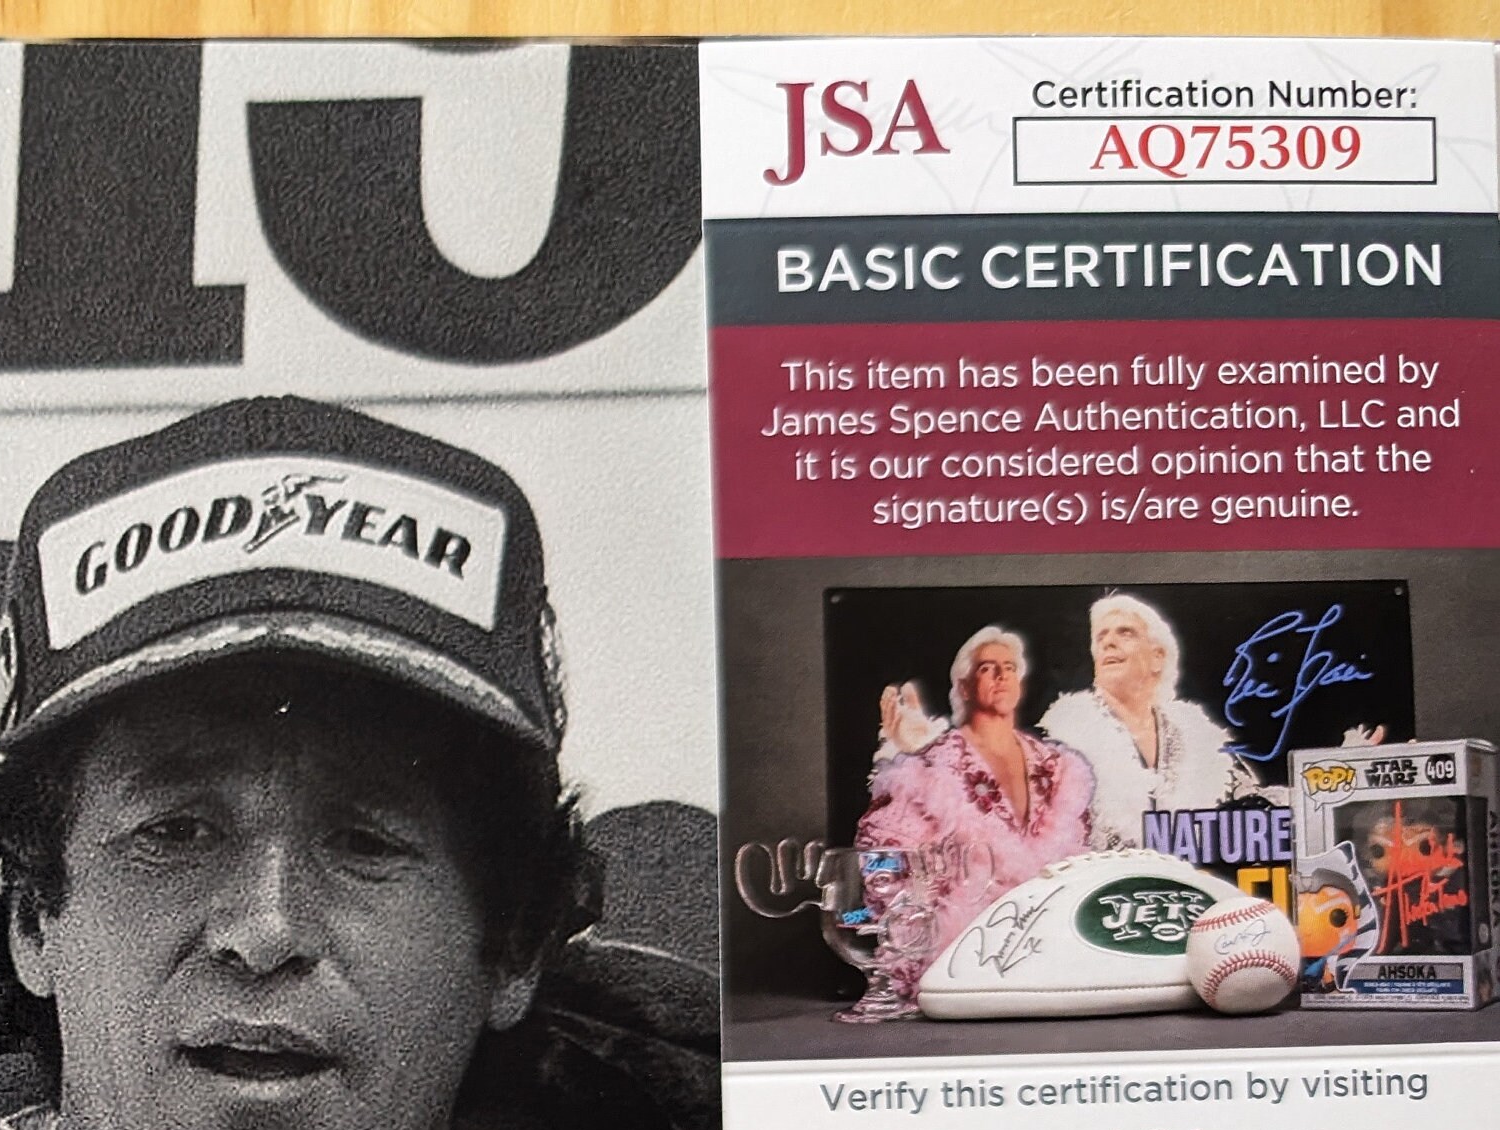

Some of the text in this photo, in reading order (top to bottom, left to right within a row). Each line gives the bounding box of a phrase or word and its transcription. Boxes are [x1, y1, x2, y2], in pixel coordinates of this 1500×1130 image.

[1033, 80, 1416, 108] Certification Number:
[763, 79, 950, 185] JSA
[1090, 124, 1362, 178] AQ75309
[778, 243, 1441, 293] BASIC CERTIFICATION
[781, 354, 1439, 391] This item has been fully examined by
[761, 399, 1459, 439] James Spence Authentication, LLC and
[796, 443, 1431, 481] it is our considered opinion that the
[874, 489, 1358, 530] signature(s) is/are genuine.
[1301, 759, 1455, 795] POP! STAR 409
[1365, 770, 1417, 787] WARS
[1144, 810, 1293, 864] NATURE
[1099, 891, 1206, 941] JETS
[1377, 966, 1437, 979] AHSOKA
[820, 1069, 1427, 1114] Verify this certification by visiting
